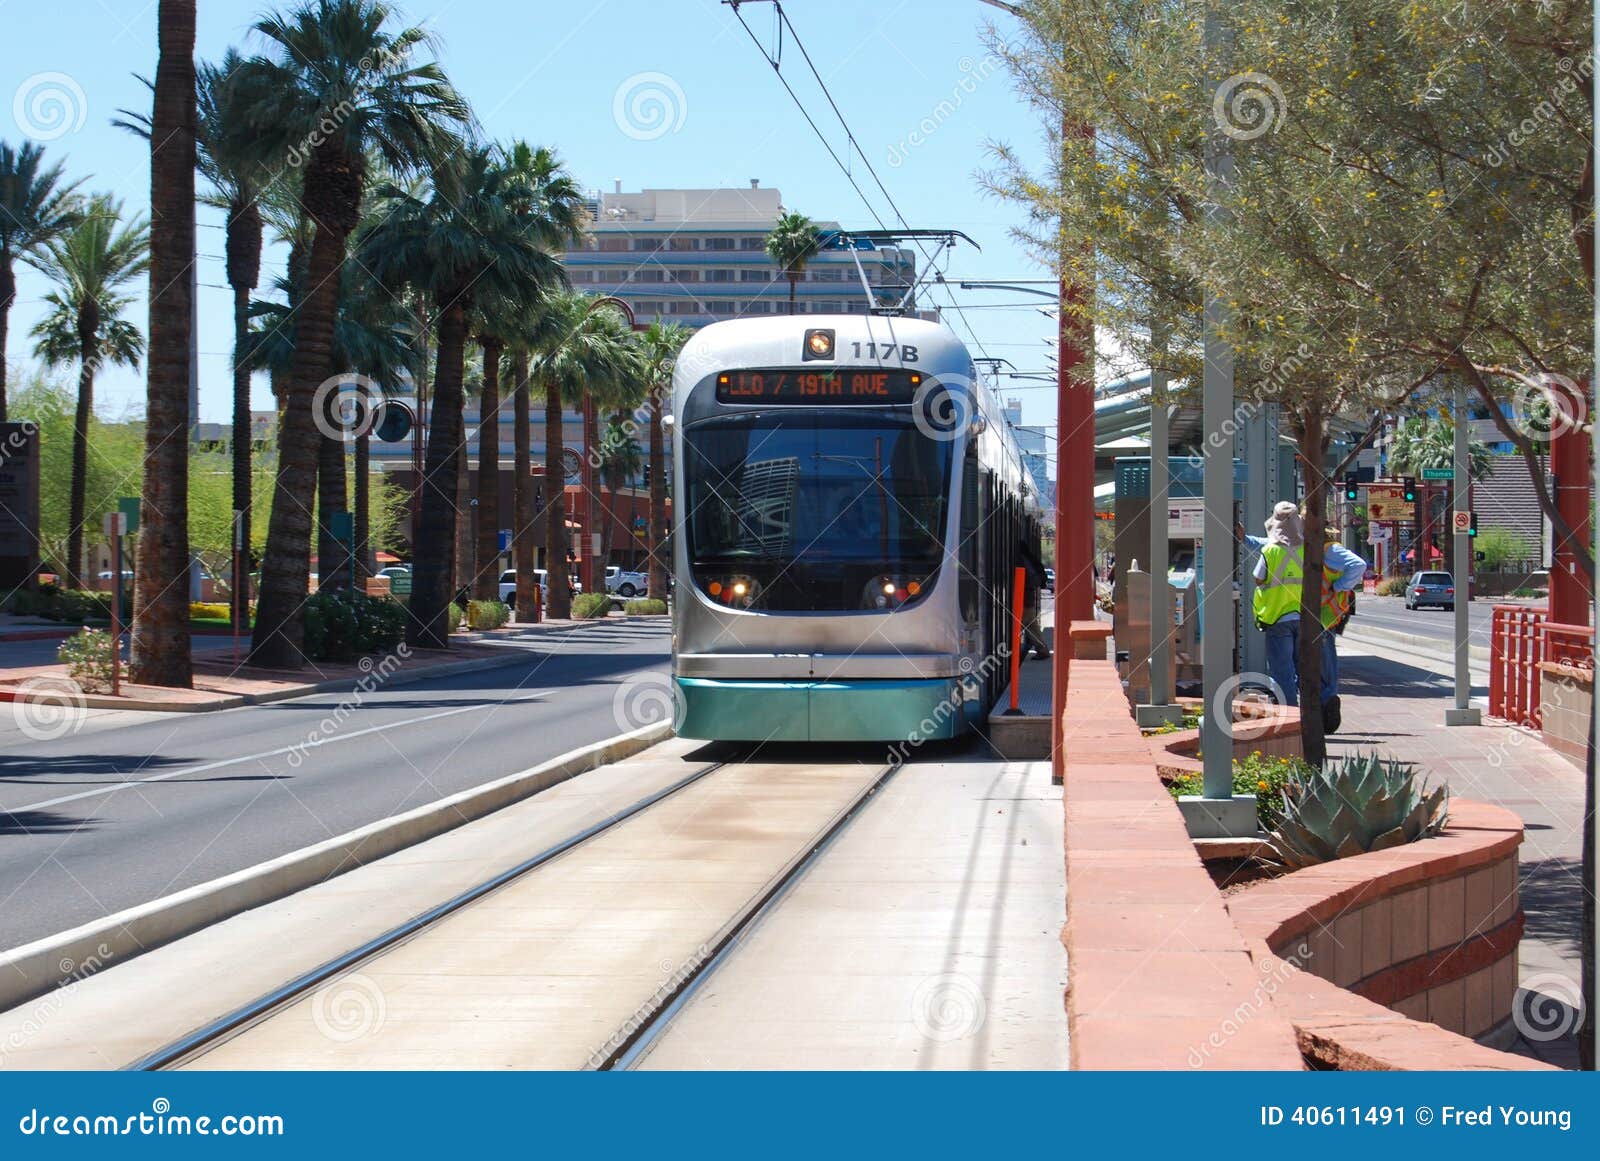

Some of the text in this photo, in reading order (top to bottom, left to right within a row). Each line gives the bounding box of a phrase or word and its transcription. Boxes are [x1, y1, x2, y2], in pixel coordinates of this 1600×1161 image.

[851, 341, 920, 363] 117B
[798, 373, 842, 396] 19TH
[851, 373, 889, 396] AVE
